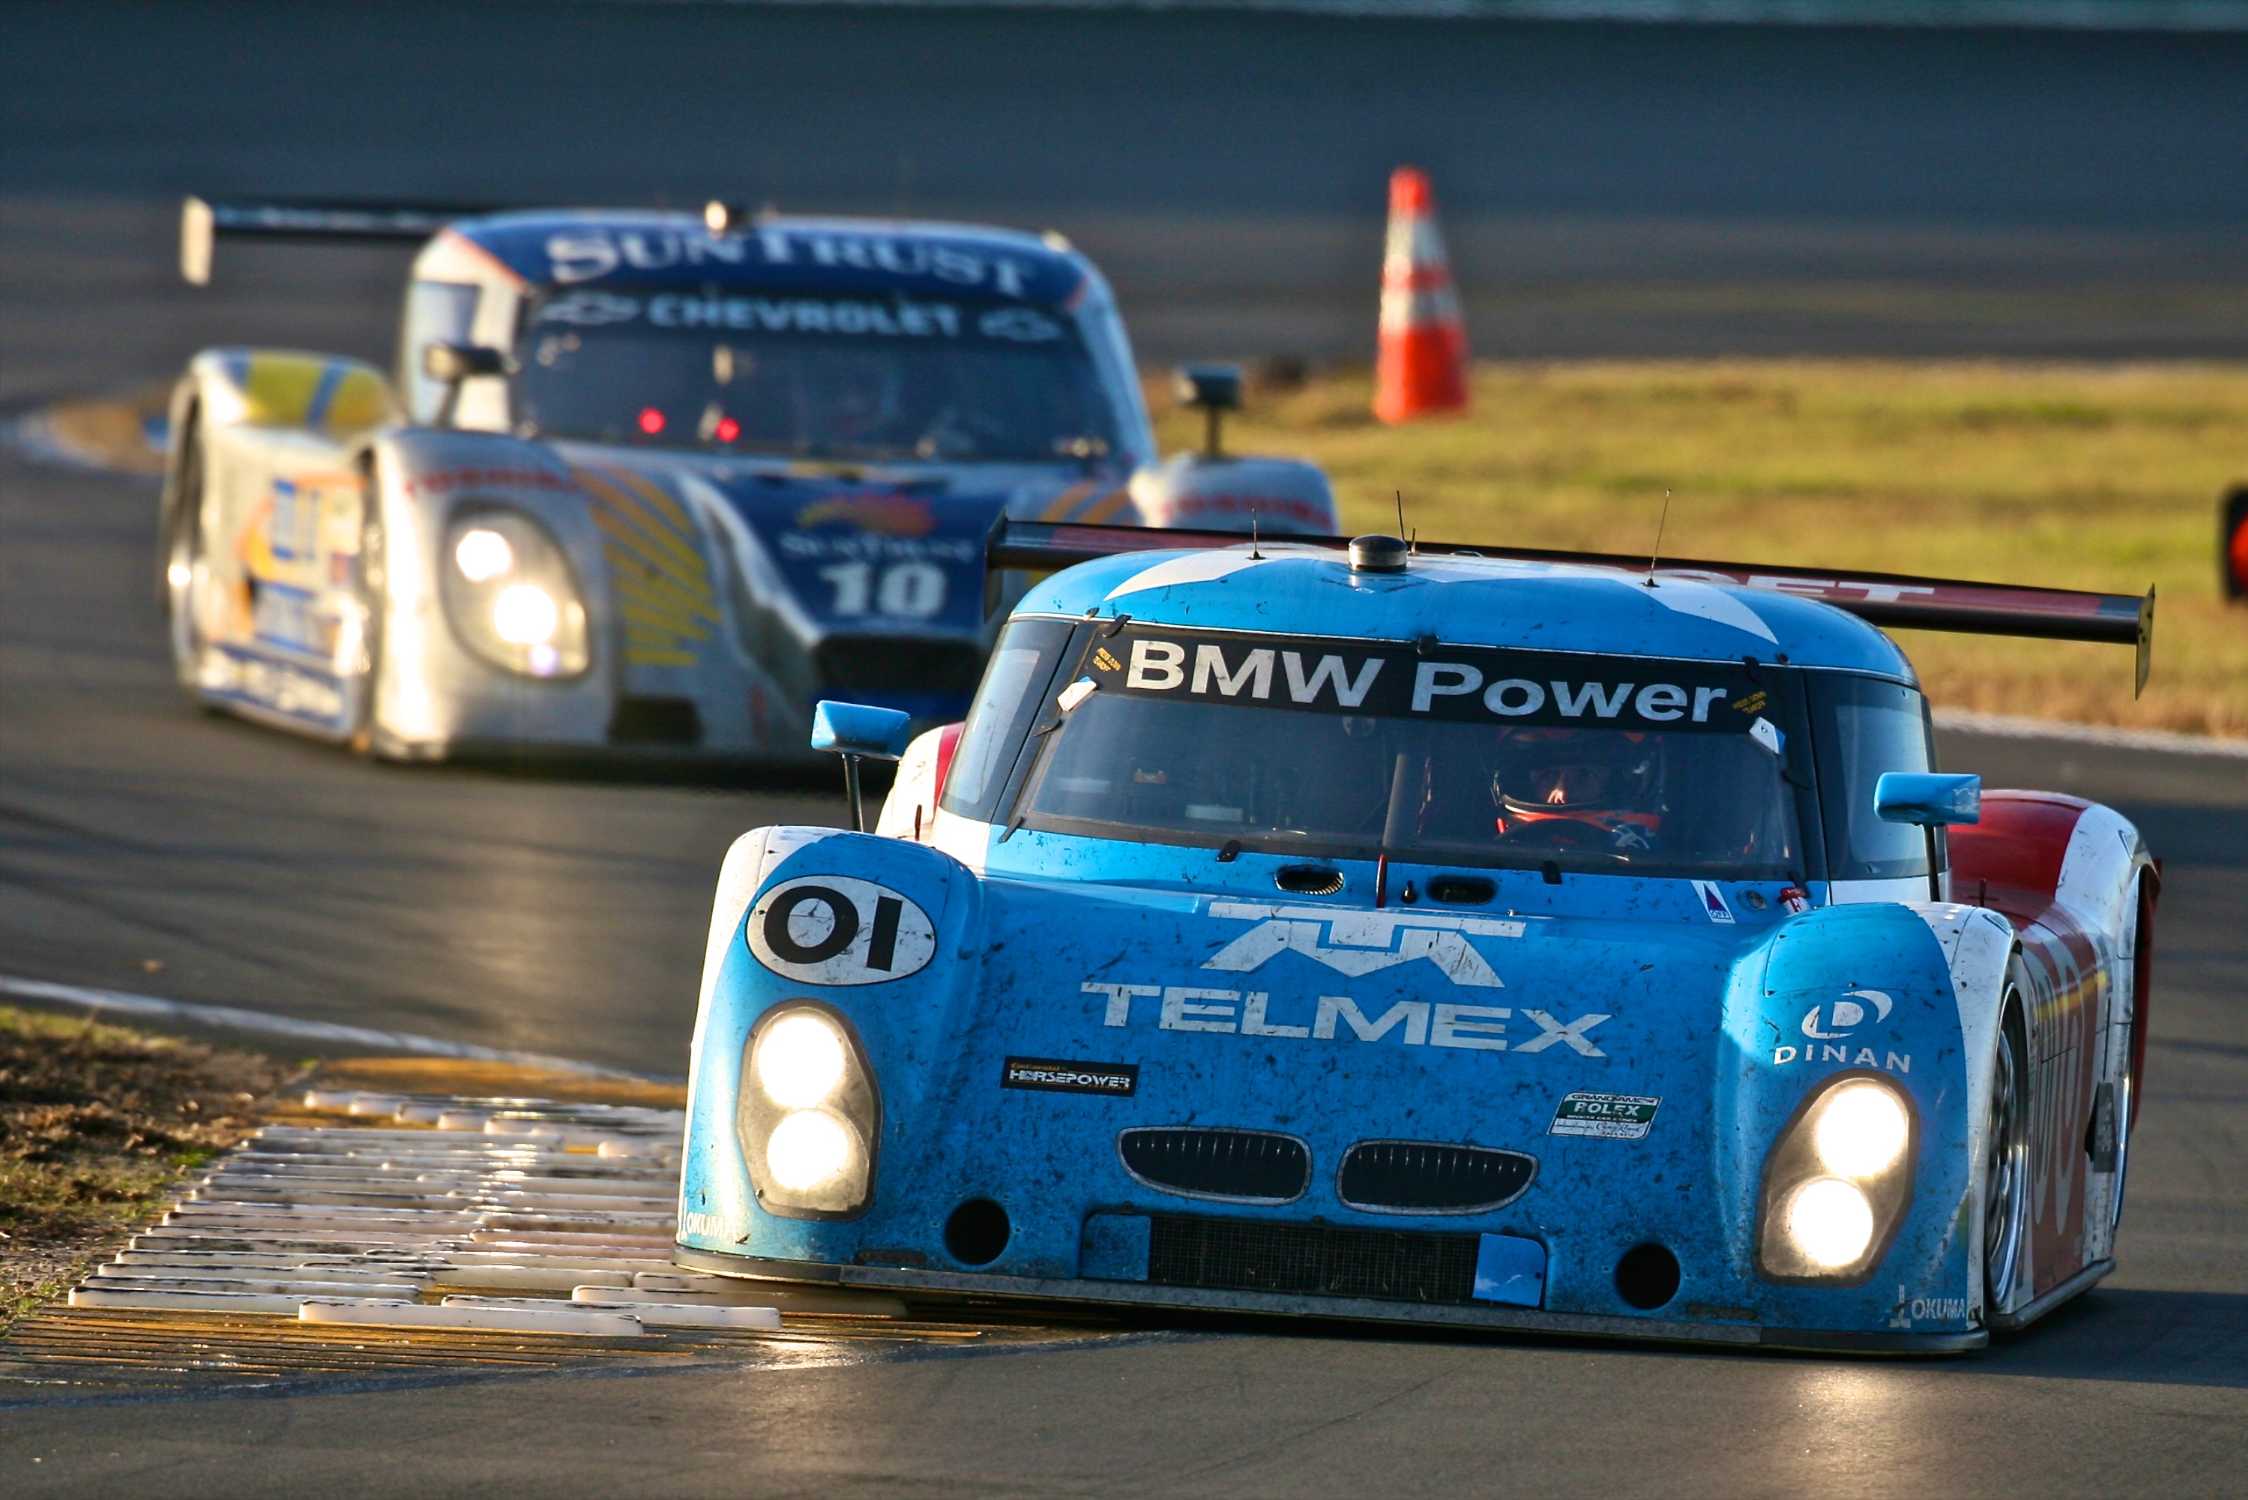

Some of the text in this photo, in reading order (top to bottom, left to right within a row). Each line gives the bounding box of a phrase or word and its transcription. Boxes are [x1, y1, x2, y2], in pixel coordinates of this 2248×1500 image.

[648, 292, 962, 337] CHEVROLET
[819, 562, 947, 616] 10
[1125, 639, 1727, 723] BMW Power
[1080, 981, 1613, 1057] TELMEX
[1774, 1044, 1911, 1073] DINAN
[1574, 1101, 1641, 1116] ROLEX
[1911, 1298, 1966, 1320] OKUMA
